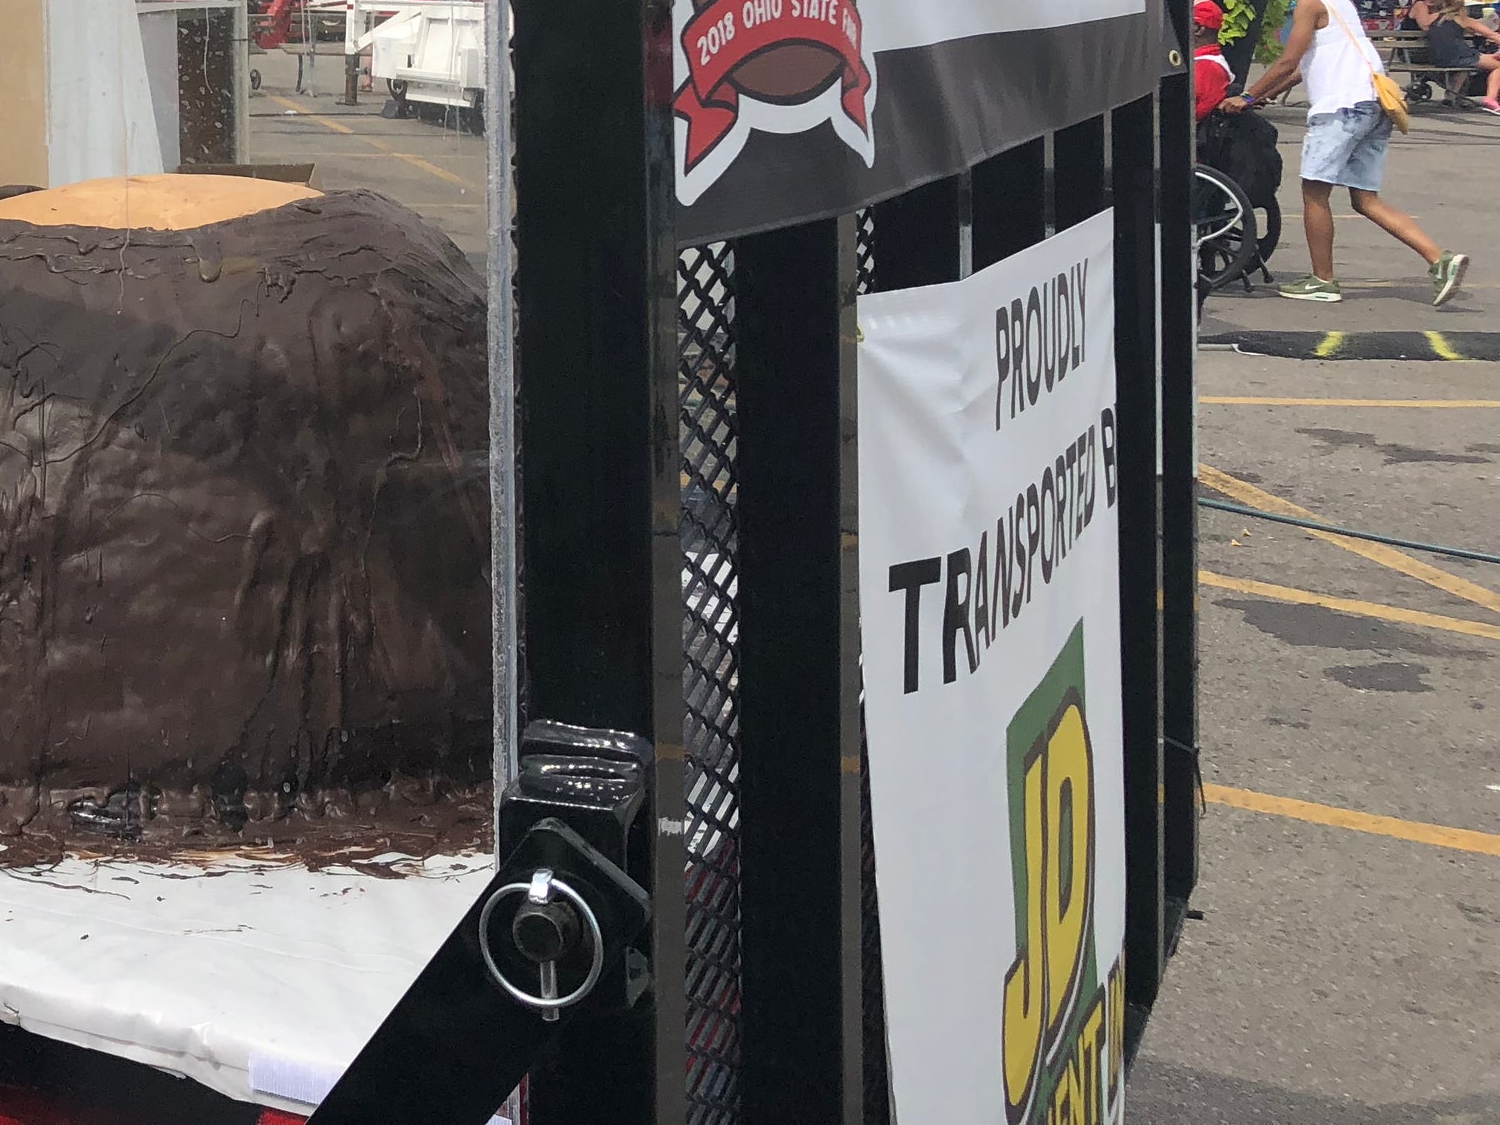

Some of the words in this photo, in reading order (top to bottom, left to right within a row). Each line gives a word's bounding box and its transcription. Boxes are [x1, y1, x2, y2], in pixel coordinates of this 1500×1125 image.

[697, 12, 735, 66] 2018
[995, 257, 1088, 431] PROUDLY
[889, 425, 1096, 695] TRANSPORTED
[1002, 685, 1094, 1125] JD
